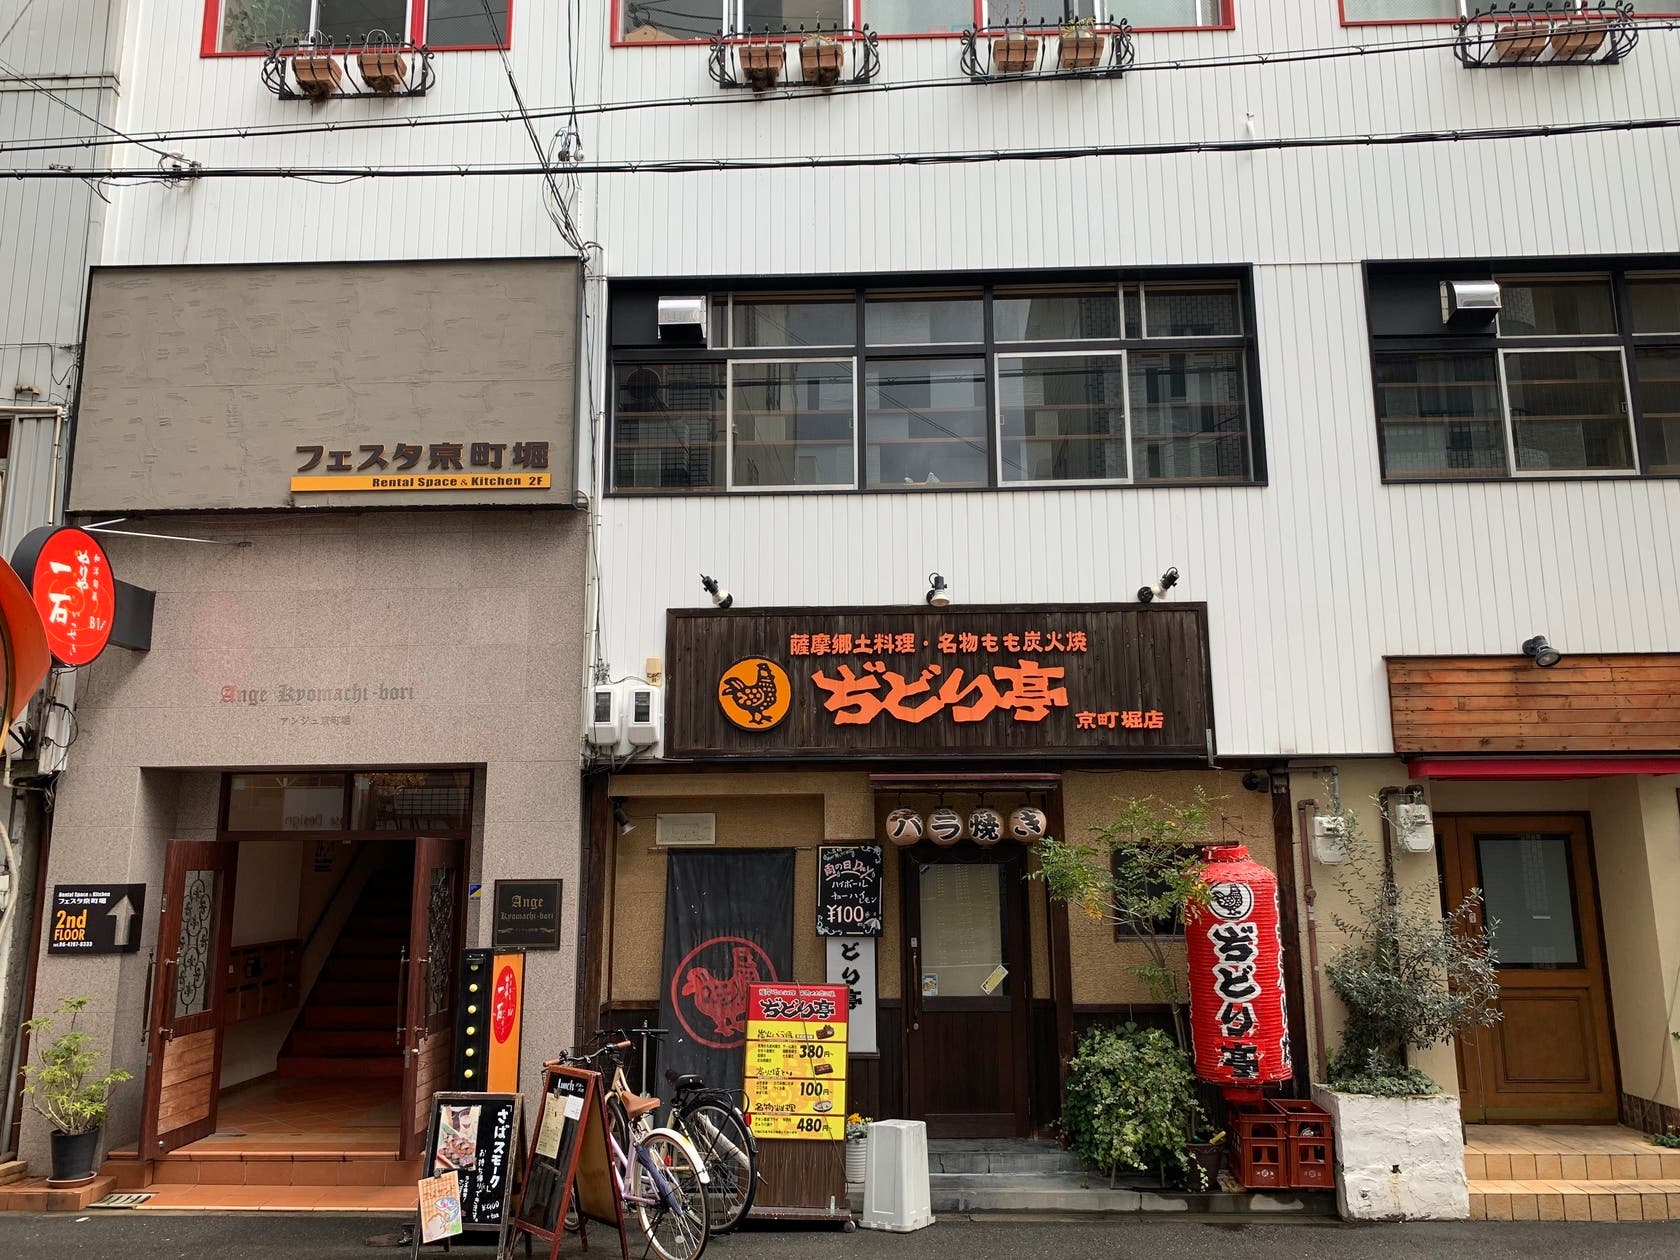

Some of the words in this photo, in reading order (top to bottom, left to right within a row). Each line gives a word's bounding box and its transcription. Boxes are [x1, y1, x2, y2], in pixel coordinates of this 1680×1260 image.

[296, 442, 549, 472] フェスタ京町堀
[373, 478, 413, 487] Rental
[418, 477, 457, 488] Space
[471, 476, 521, 486] Kitchen
[529, 476, 543, 486] 2F
[789, 631, 1087, 656] 薩摩郷土料理・名物もも炭火焼
[811, 659, 1069, 725] ぢどり亭
[1075, 710, 1164, 731] 京町堀店
[892, 810, 1042, 841] バラ焼き
[831, 879, 868, 888] ハイボール
[511, 895, 544, 909] Ange
[55, 909, 88, 928] 2nd
[826, 904, 864, 923] ¥100
[54, 929, 86, 940] FLOOR
